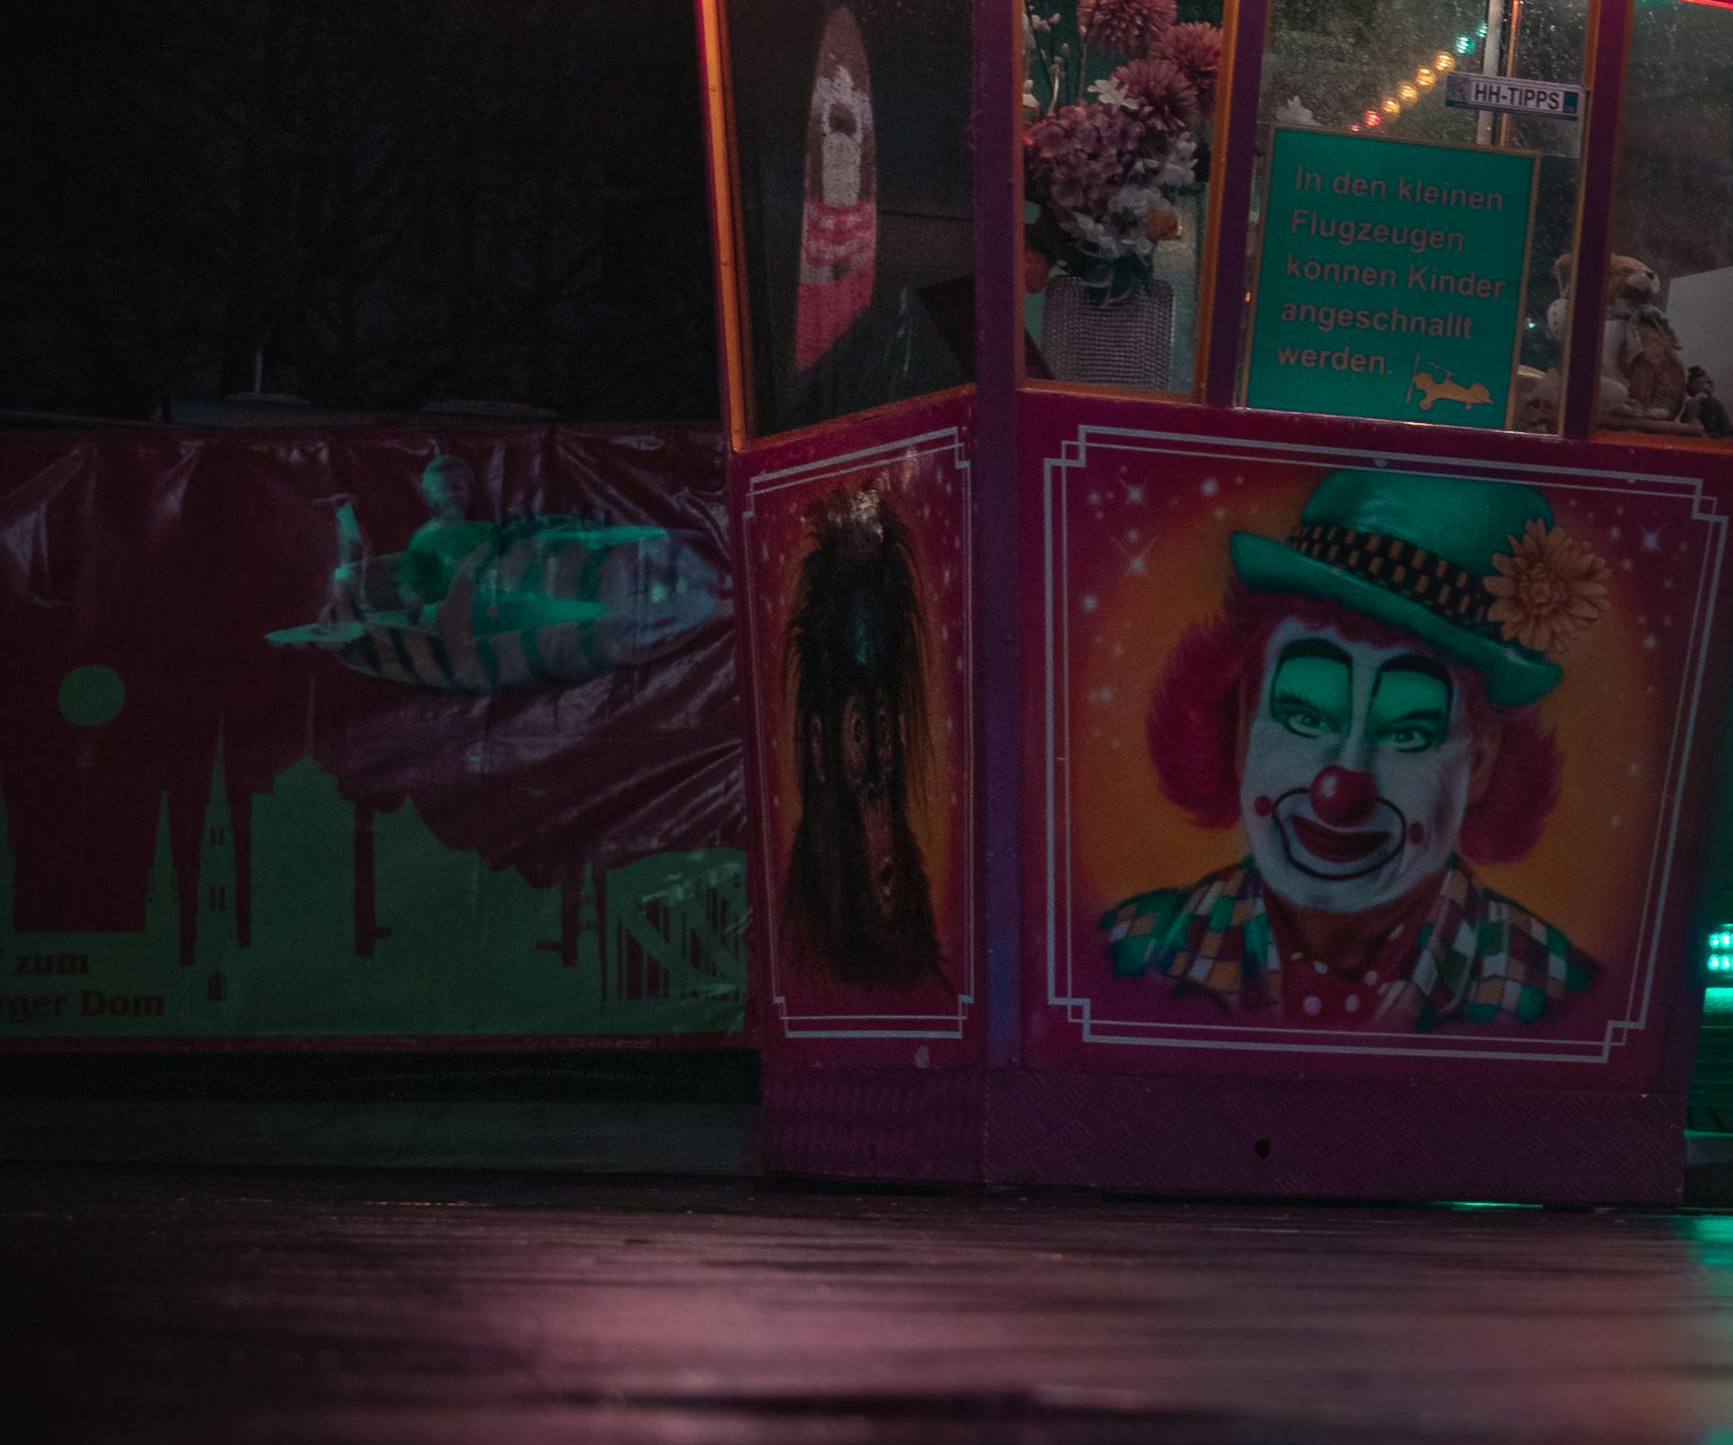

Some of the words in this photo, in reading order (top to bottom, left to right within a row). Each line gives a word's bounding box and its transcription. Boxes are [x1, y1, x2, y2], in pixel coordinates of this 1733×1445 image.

[1473, 82, 1560, 111] HH-TIPPS
[1295, 166, 1321, 193] In
[1333, 171, 1387, 199] den
[1397, 175, 1504, 212] kleinen
[1290, 209, 1464, 253] Flugzeugen
[1285, 252, 1396, 288] können
[1407, 265, 1505, 299] Kinder
[1281, 301, 1473, 341] angeschnallt
[15, 953, 90, 975] zum
[81, 989, 165, 1017] Dom
